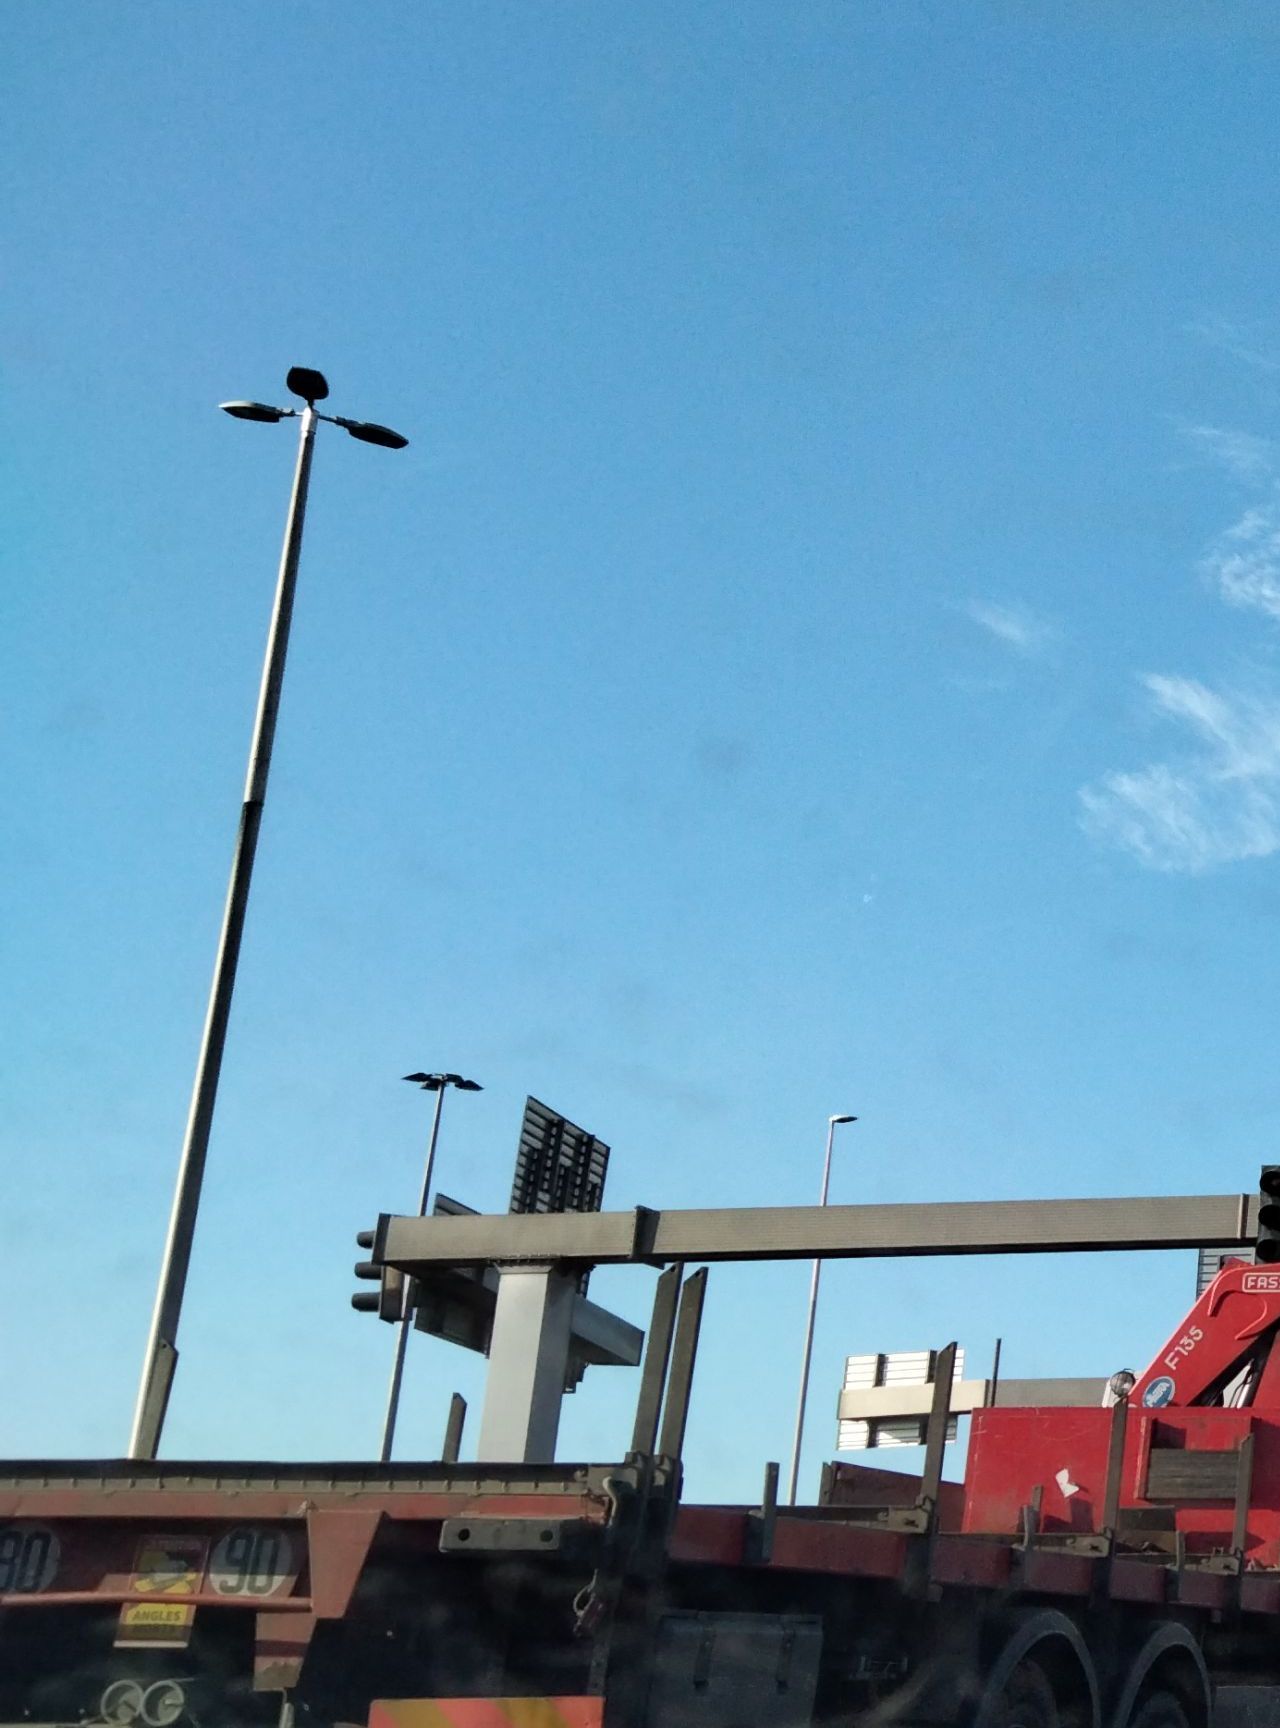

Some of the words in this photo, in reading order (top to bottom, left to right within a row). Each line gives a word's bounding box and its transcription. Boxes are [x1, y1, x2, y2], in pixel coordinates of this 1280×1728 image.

[1164, 1325, 1204, 1371] F135
[219, 1529, 282, 1595] 90
[132, 1610, 183, 1622] ANGLES
